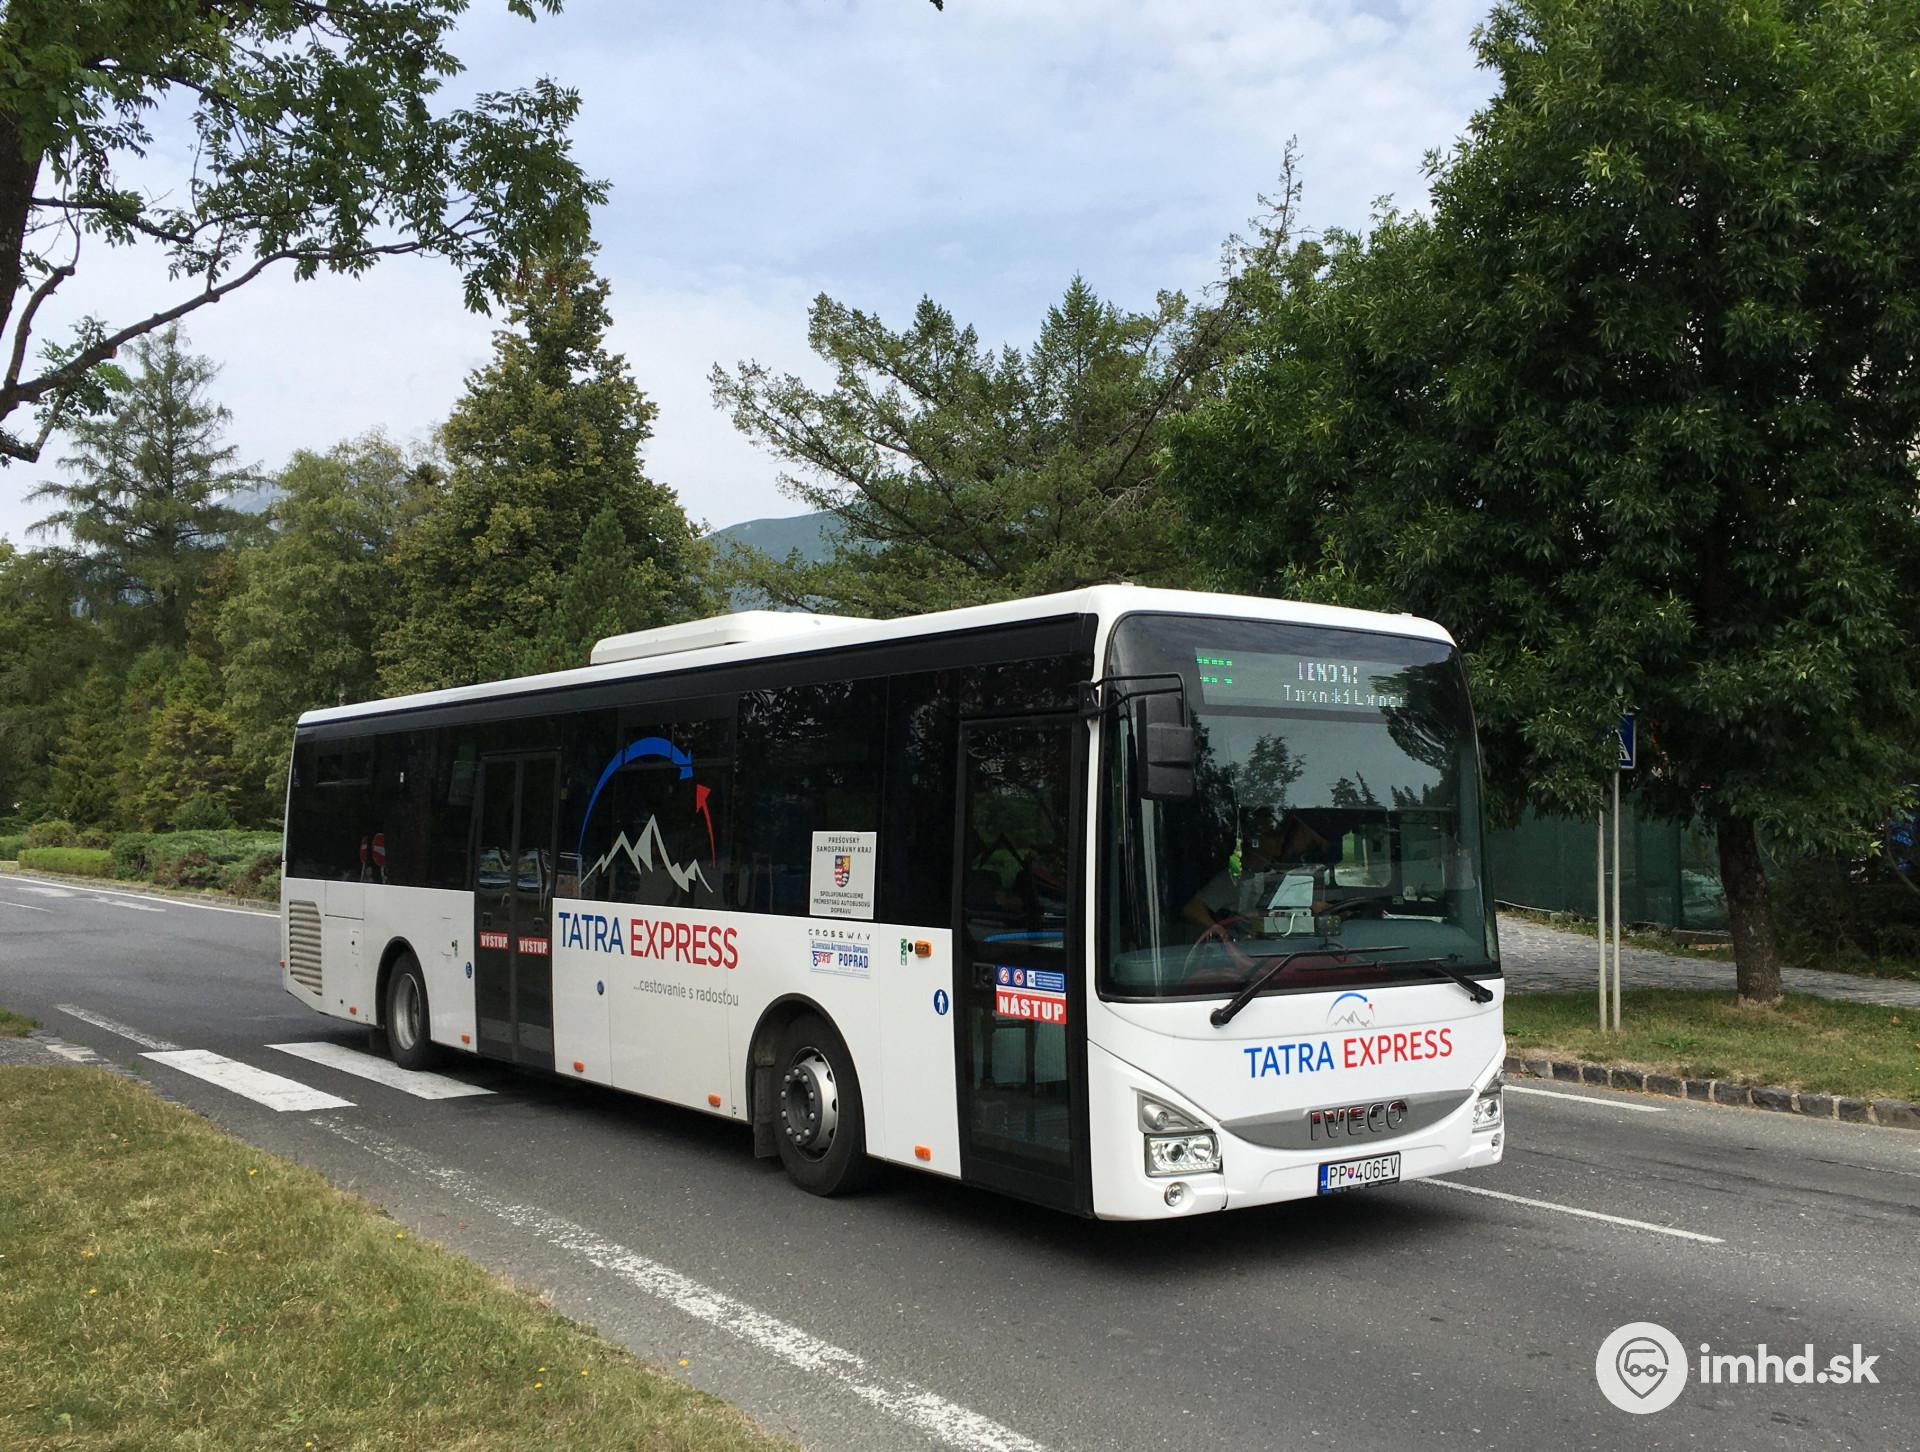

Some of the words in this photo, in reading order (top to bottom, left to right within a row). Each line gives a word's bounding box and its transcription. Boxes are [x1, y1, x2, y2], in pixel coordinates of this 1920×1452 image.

[857, 846, 872, 854] KRAJ
[480, 933, 508, 949] VÝSTUP
[519, 938, 548, 954] VÝSTUP
[559, 912, 624, 955] TATRA
[631, 918, 739, 970] EXPRESS
[838, 952, 869, 969] POPRAD
[688, 986, 694, 1000] s
[998, 994, 1064, 1021] NÁSTUP
[1243, 1040, 1335, 1078] TATRA
[1343, 1027, 1453, 1069] EXPRESS
[1310, 1099, 1409, 1142] IVECO
[1329, 1165, 1348, 1187] PP
[1355, 1156, 1398, 1182] 406EV
